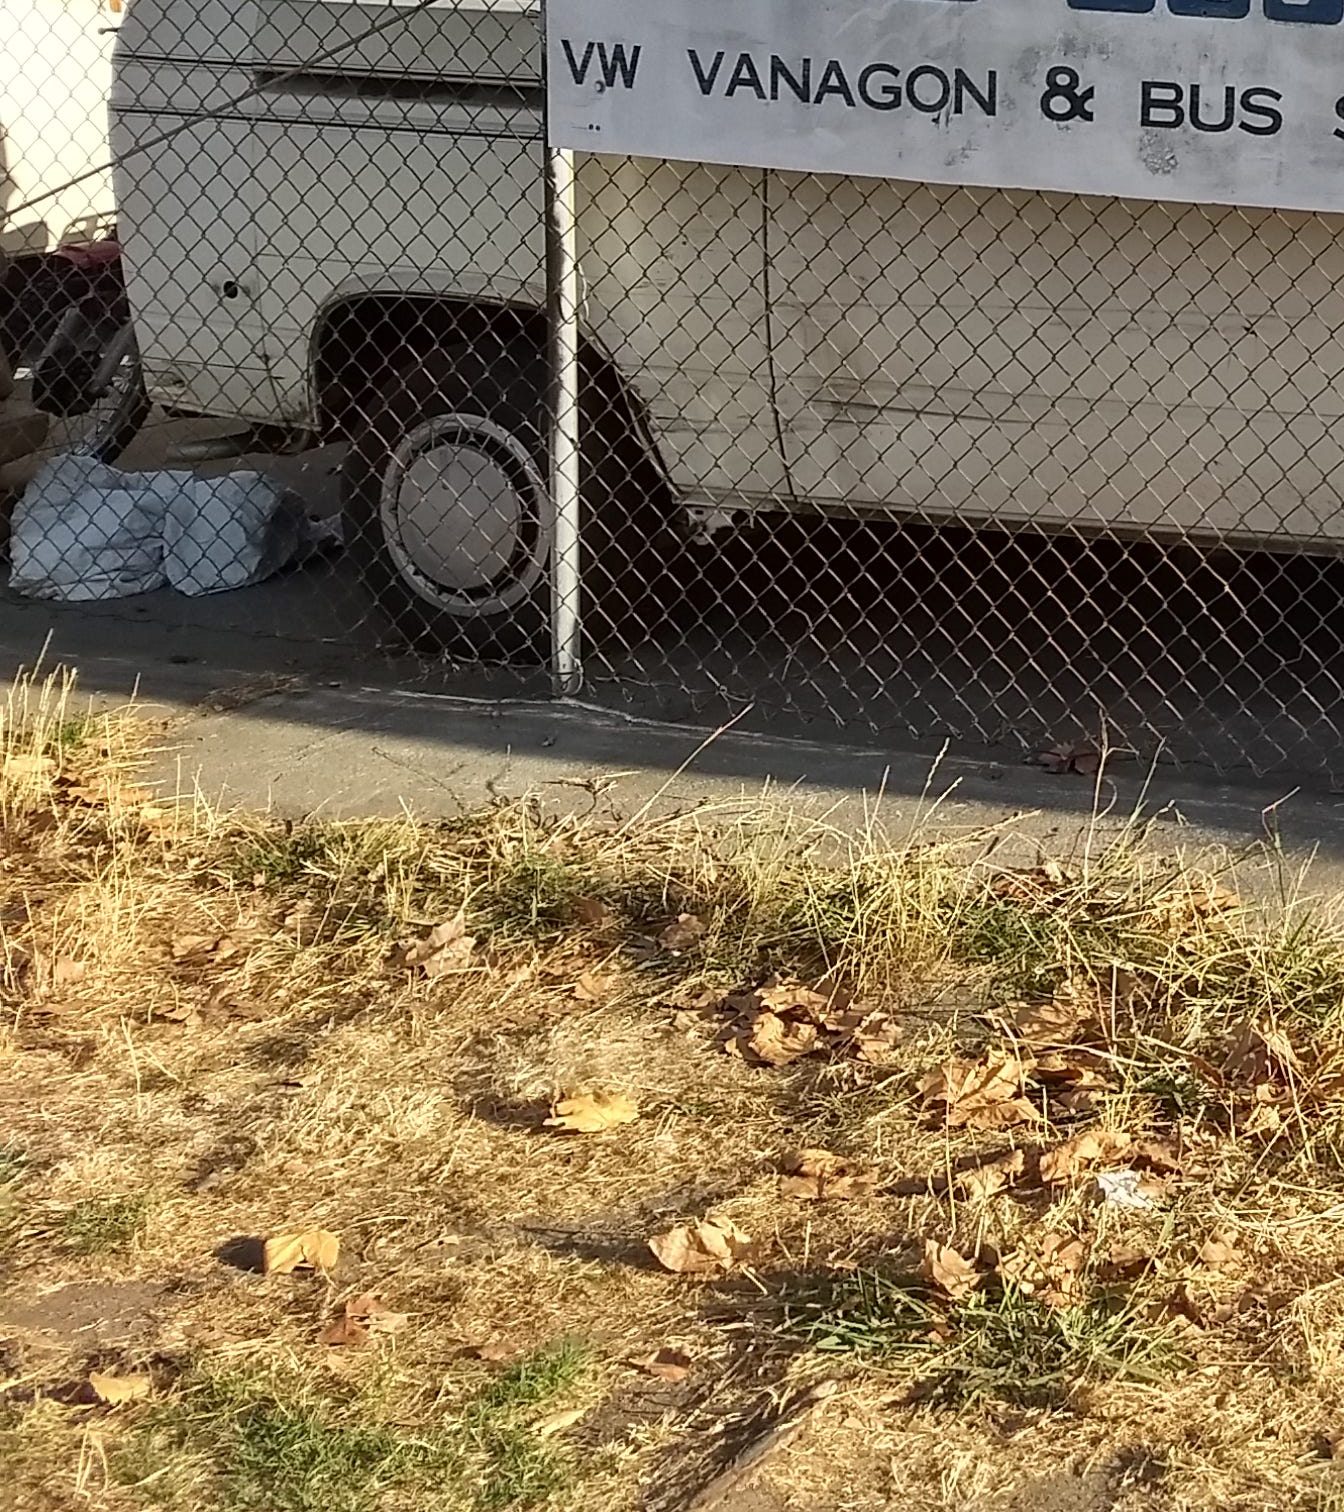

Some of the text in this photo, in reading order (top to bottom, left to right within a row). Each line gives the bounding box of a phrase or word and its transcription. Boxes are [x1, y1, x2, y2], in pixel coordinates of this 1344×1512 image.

[560, 39, 641, 90] VW
[687, 48, 997, 117] VANAGON
[1039, 65, 1095, 122] &
[1140, 81, 1283, 136] BUS
